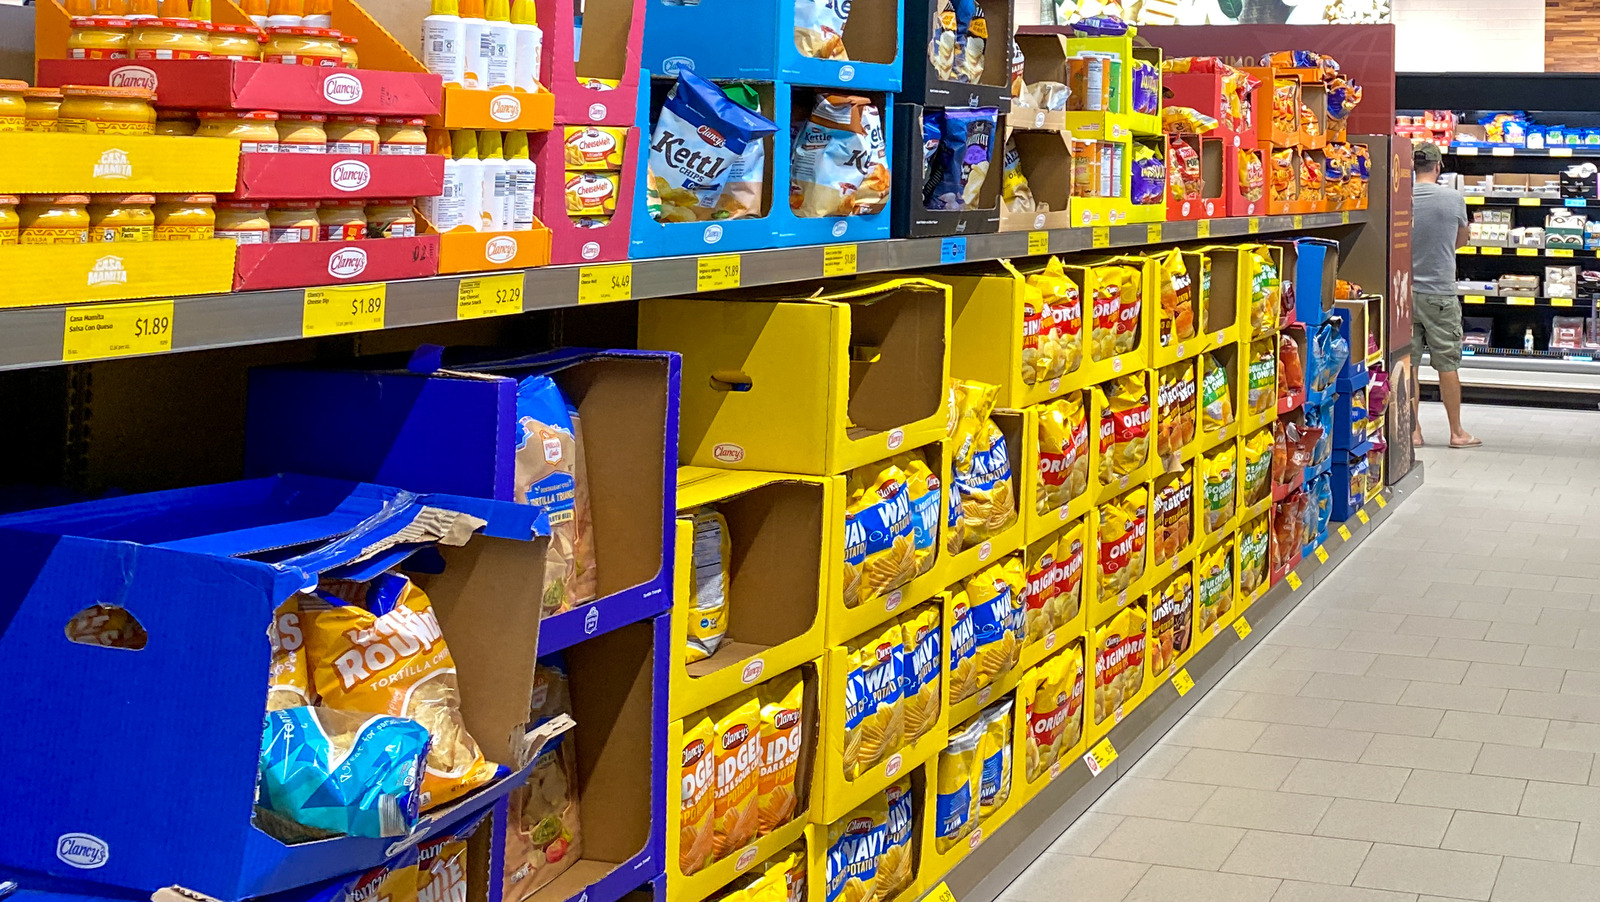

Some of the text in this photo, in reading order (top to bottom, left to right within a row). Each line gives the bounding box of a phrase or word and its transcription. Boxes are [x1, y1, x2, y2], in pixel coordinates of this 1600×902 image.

[112, 73, 156, 89] Clancy's
[326, 80, 360, 98] Clancy's
[492, 100, 520, 118] Clancy's
[697, 125, 727, 148] Clancy's
[100, 153, 129, 164] CASA
[93, 163, 132, 178] MAMITA
[333, 167, 369, 185] Clancy's
[678, 166, 705, 182] CHIPS
[487, 242, 516, 260] Clancy's
[95, 259, 123, 271] CASA
[330, 254, 366, 271] Clancy's
[724, 265, 739, 278] $1.89
[87, 270, 127, 286] MAMITA
[611, 275, 630, 290] $4.49
[496, 288, 520, 304] $2.29
[351, 297, 381, 316] $1.89
[84, 313, 105, 321] Mamita
[96, 322, 113, 330] Queso
[135, 316, 169, 338] $1.89
[1123, 408, 1150, 428] ORIG
[713, 445, 744, 460] Clancy's
[878, 487, 910, 528] WAV
[1110, 537, 1133, 559] ORIG
[1054, 551, 1082, 582] ORIGIN
[991, 592, 1012, 622] WAV
[951, 614, 974, 651] WAV
[370, 661, 432, 692] TORTILLA
[1035, 705, 1069, 734] ORIGIN
[722, 724, 749, 750] Clancy's
[766, 728, 802, 765] IDG
[717, 731, 761, 788] IDGE
[60, 839, 106, 866] Clancy's
[847, 859, 873, 877] POTATO
